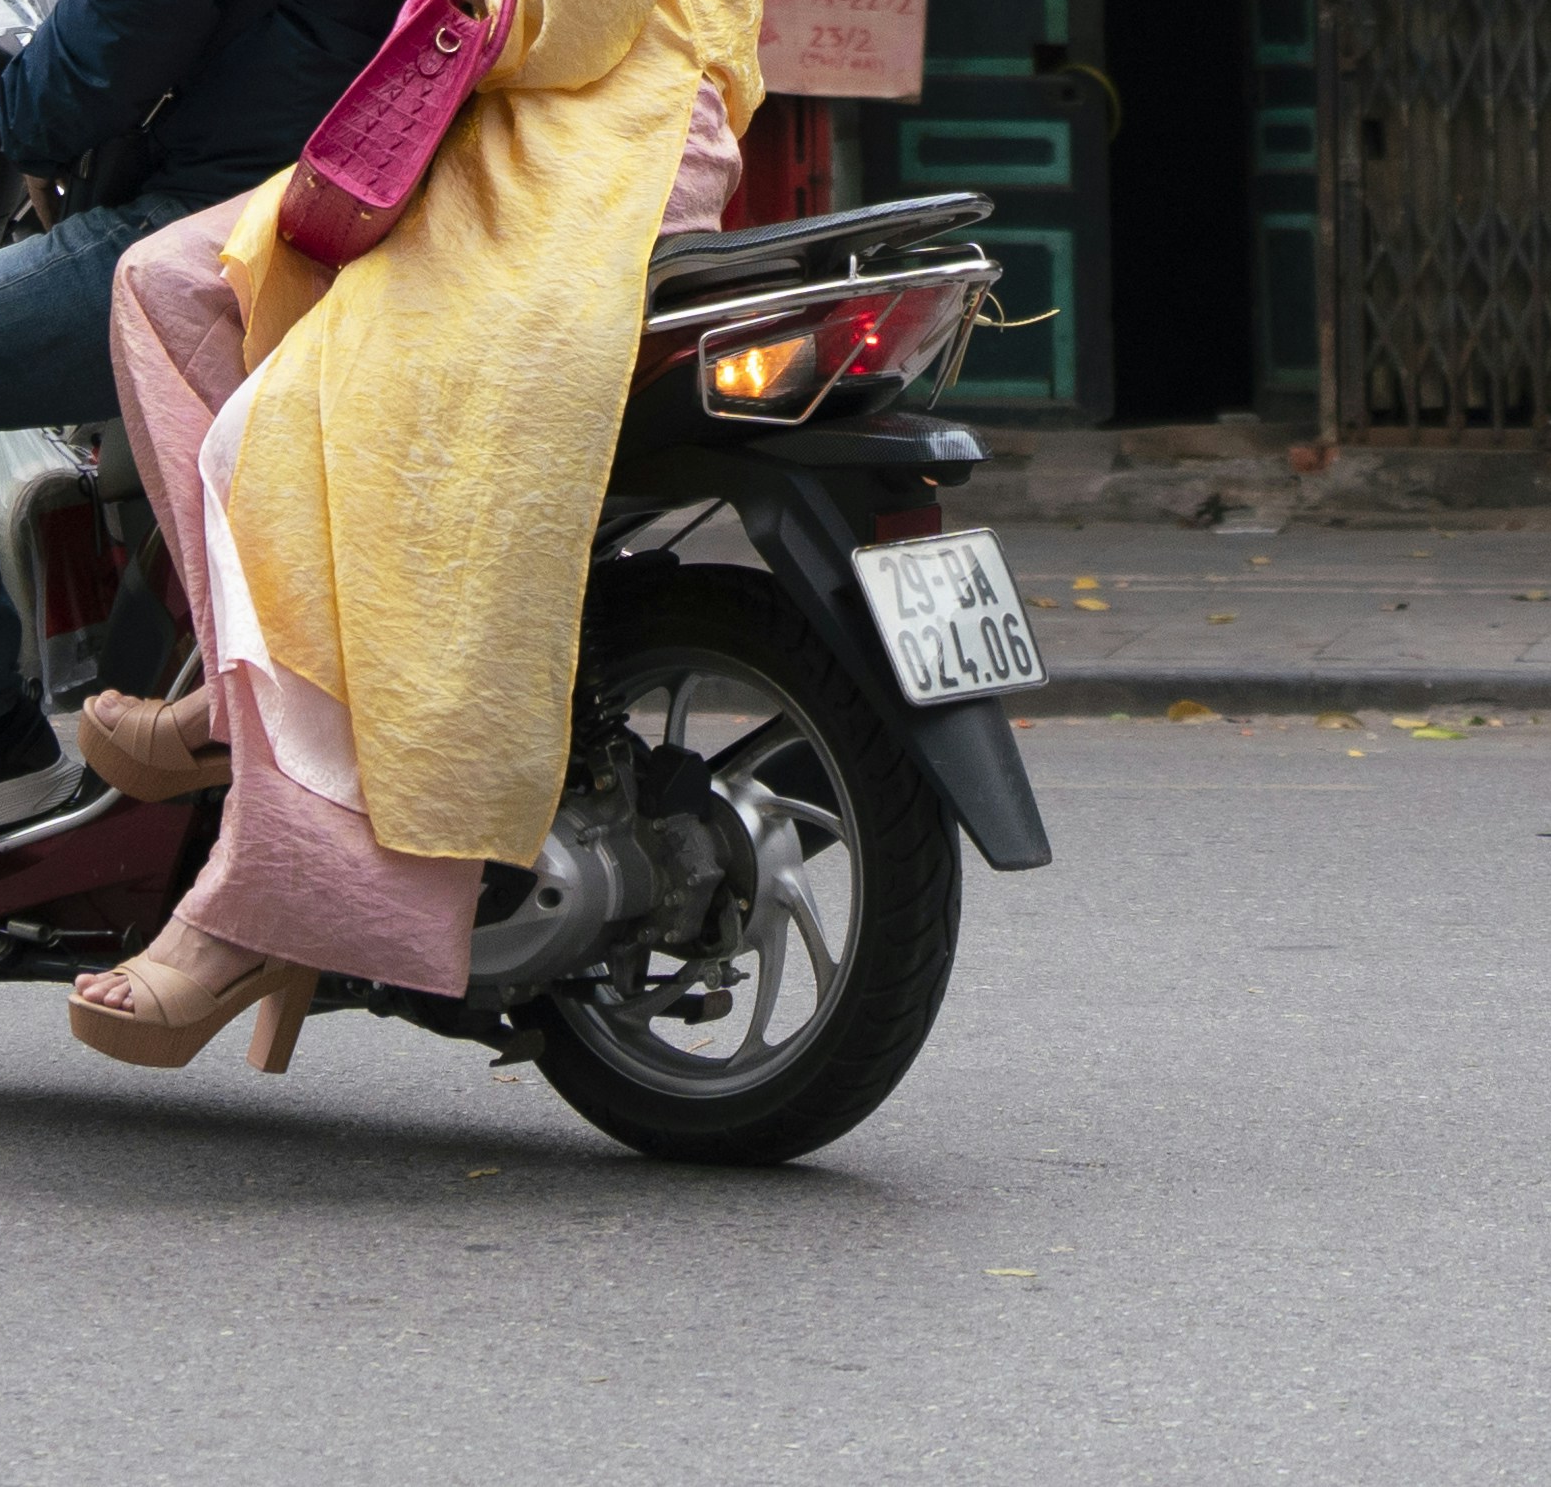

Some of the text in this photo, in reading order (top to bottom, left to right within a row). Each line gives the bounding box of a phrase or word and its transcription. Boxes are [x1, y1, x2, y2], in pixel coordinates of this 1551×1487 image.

[810, 25, 876, 53] 23/2
[879, 544, 999, 621] 29-BA
[897, 612, 1033, 692] 024.06
